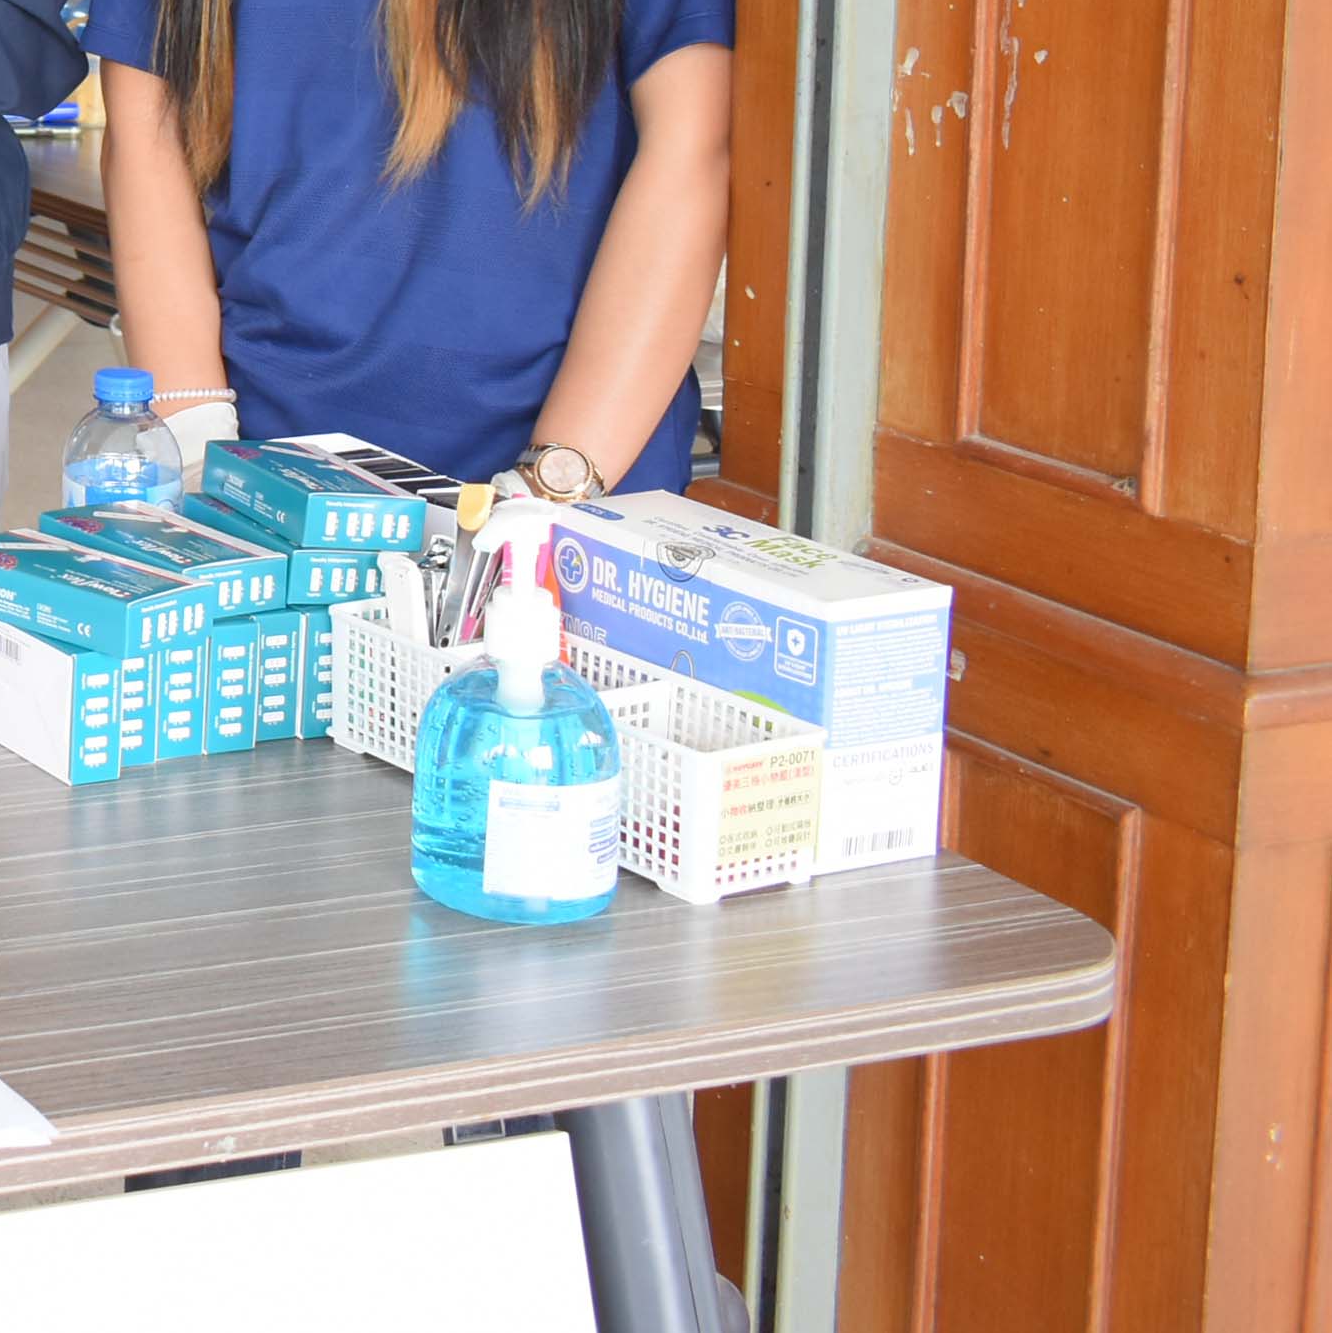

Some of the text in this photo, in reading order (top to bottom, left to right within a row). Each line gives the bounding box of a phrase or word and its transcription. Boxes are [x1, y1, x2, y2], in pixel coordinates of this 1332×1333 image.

[744, 538, 827, 569] Mask
[592, 556, 710, 627] DR. HYGIENE
[592, 587, 627, 613] MEDICAL
[629, 600, 673, 632] PRODUCTS
[770, 750, 815, 768] P2-0071
[833, 744, 935, 769] CERTIFICATIONS
